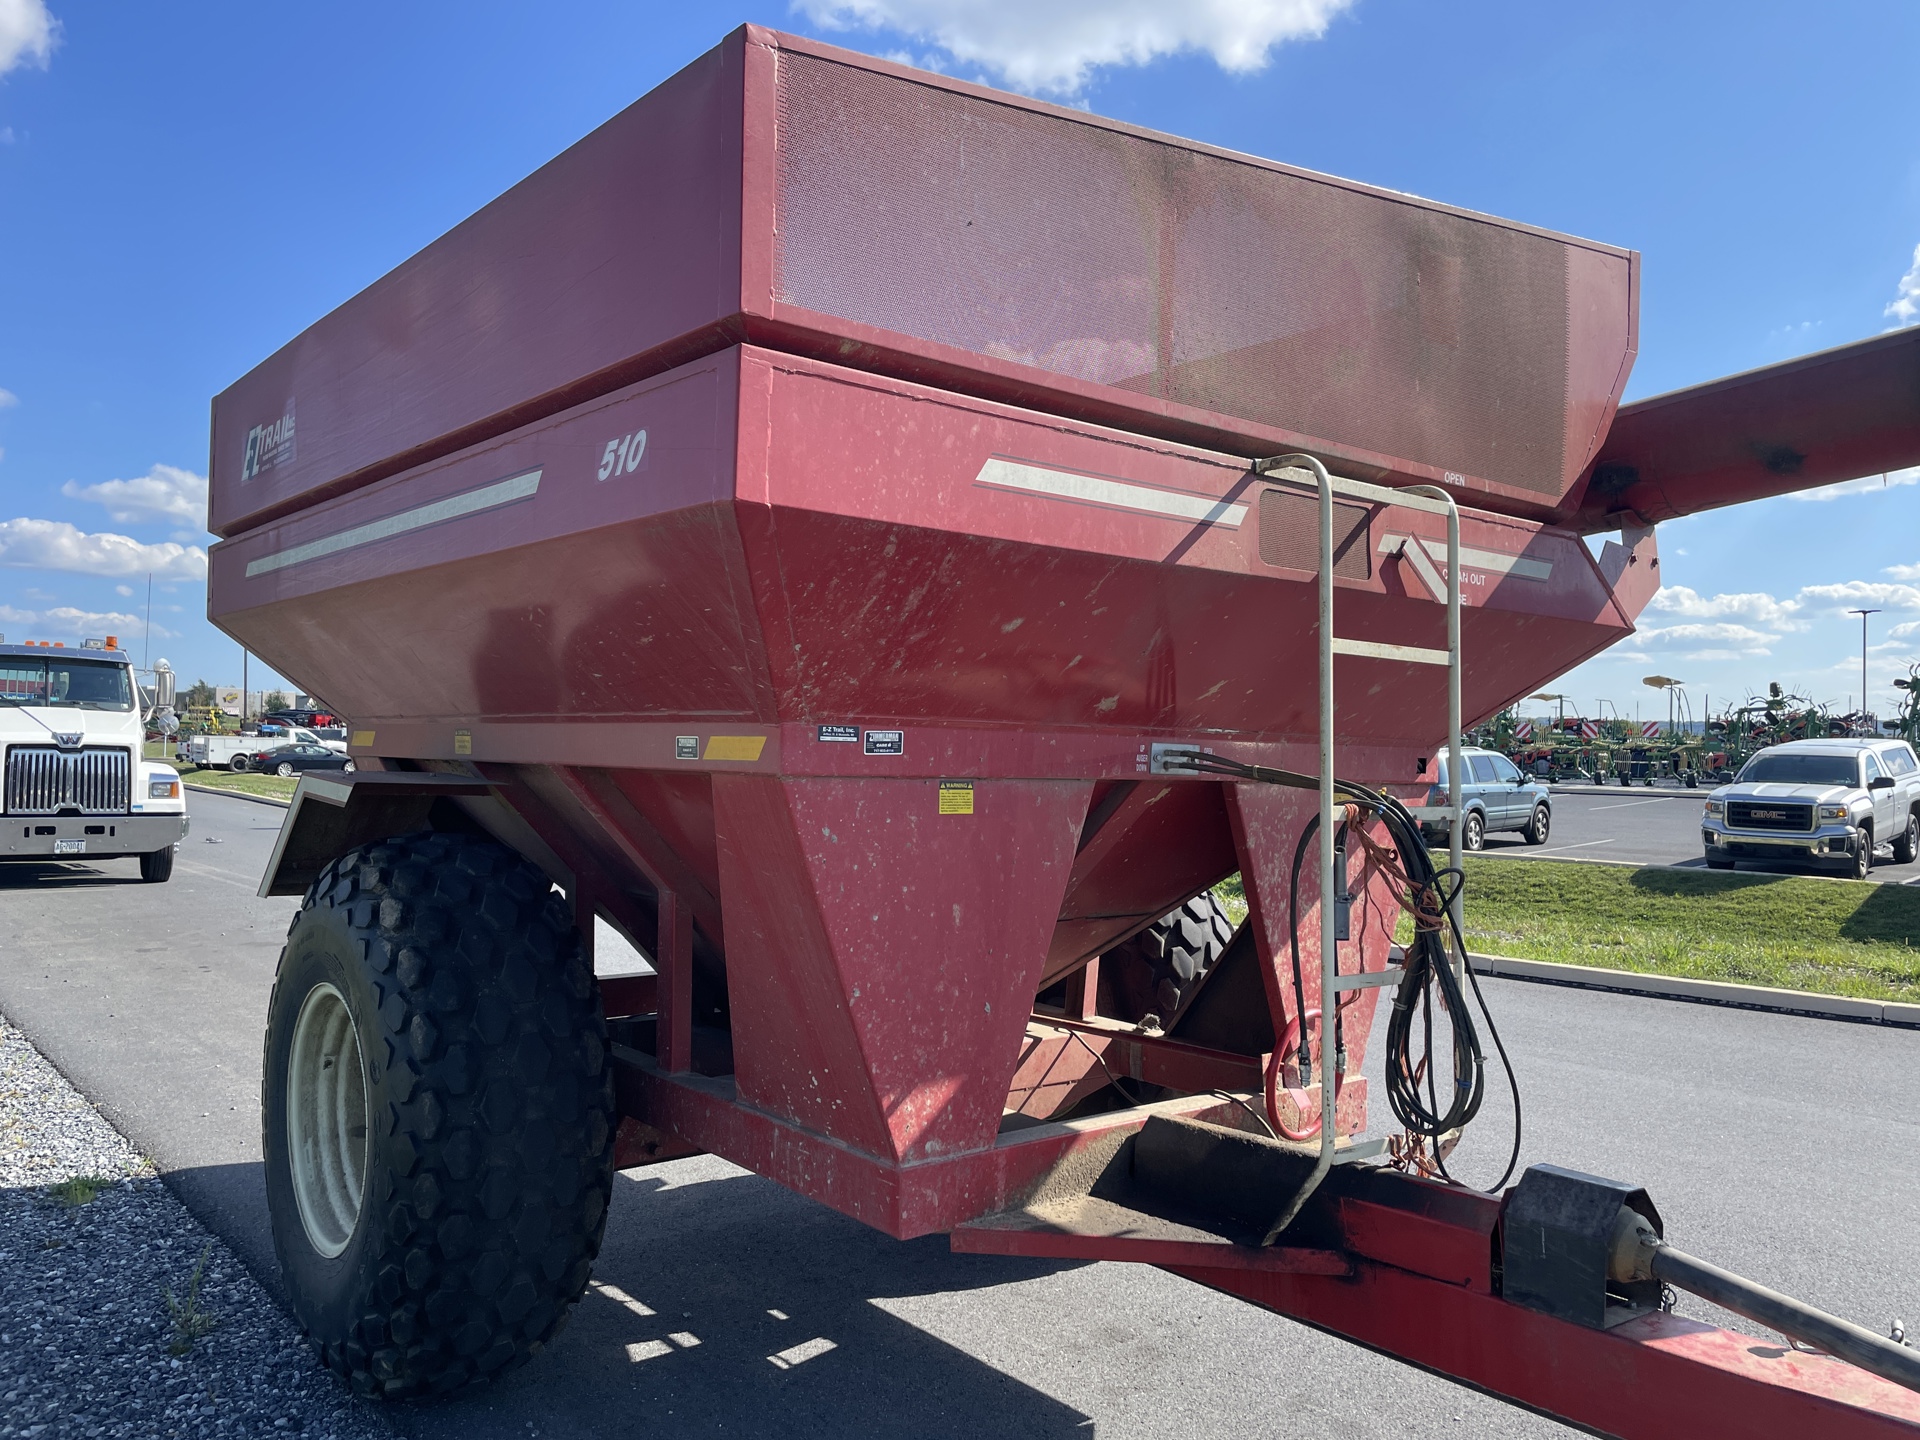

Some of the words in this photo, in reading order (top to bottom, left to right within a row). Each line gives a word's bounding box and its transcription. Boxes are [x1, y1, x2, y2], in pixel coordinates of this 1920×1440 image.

[260, 414, 295, 455] TRAIL
[598, 430, 647, 482] 510
[1444, 471, 1465, 487] OPEN
[1442, 568, 1469, 584] CAN
[1470, 573, 1486, 586] OUT
[1751, 809, 1786, 819] GMC
